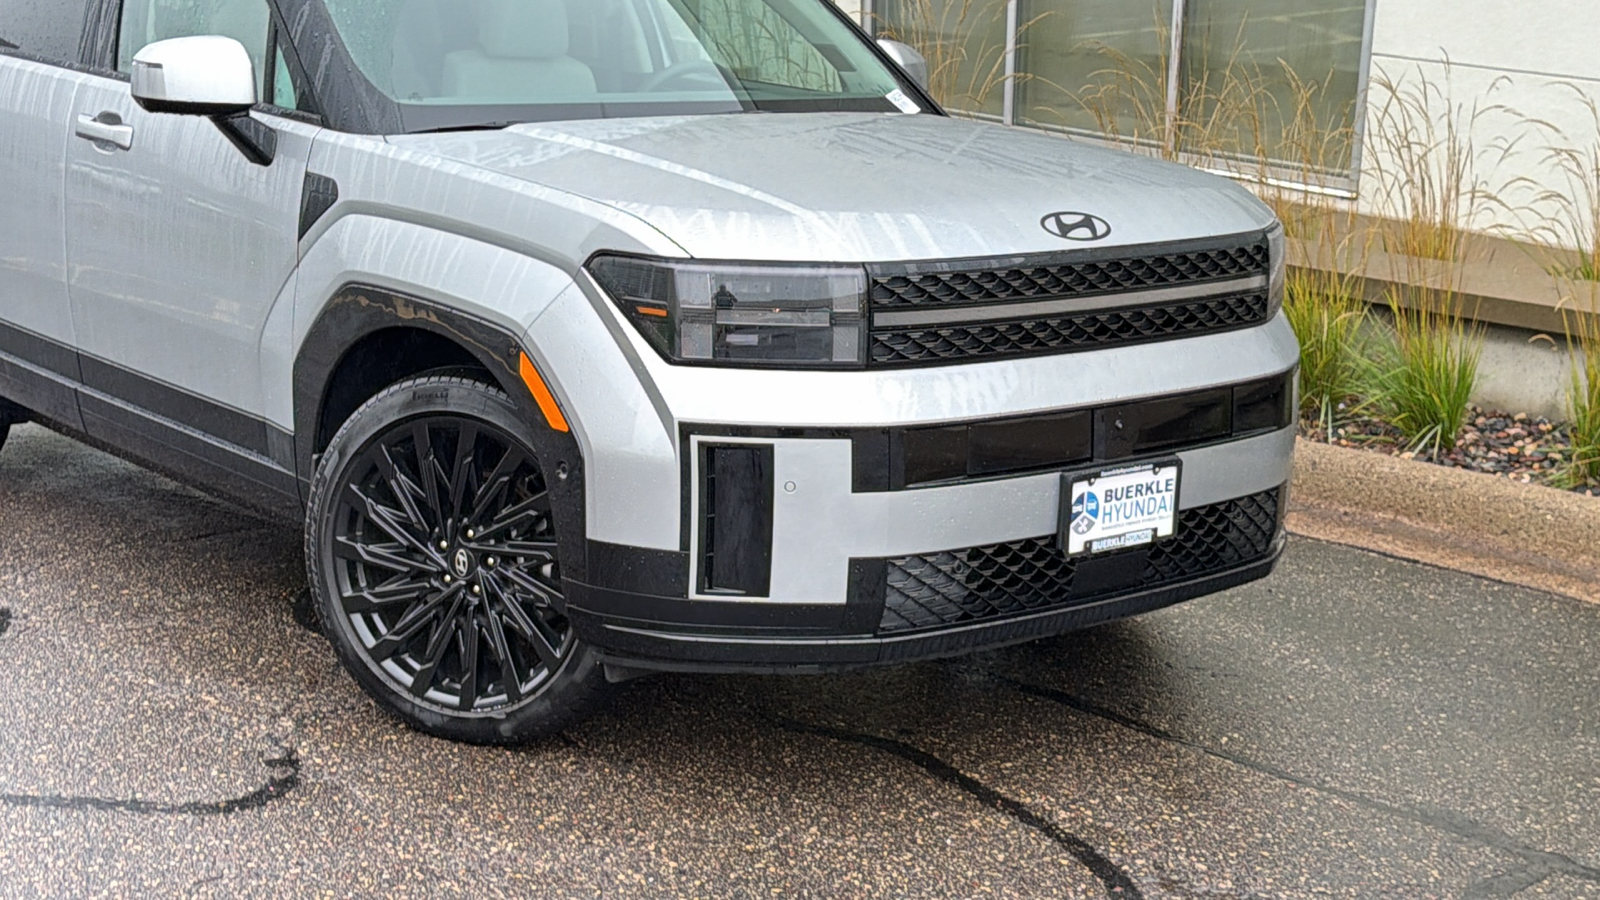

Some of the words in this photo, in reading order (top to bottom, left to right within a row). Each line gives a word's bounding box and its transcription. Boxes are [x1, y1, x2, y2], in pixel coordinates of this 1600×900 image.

[1104, 478, 1174, 503] BUERKLE
[1102, 495, 1173, 524] HYUNDAI
[1092, 536, 1126, 551] BUERKLE
